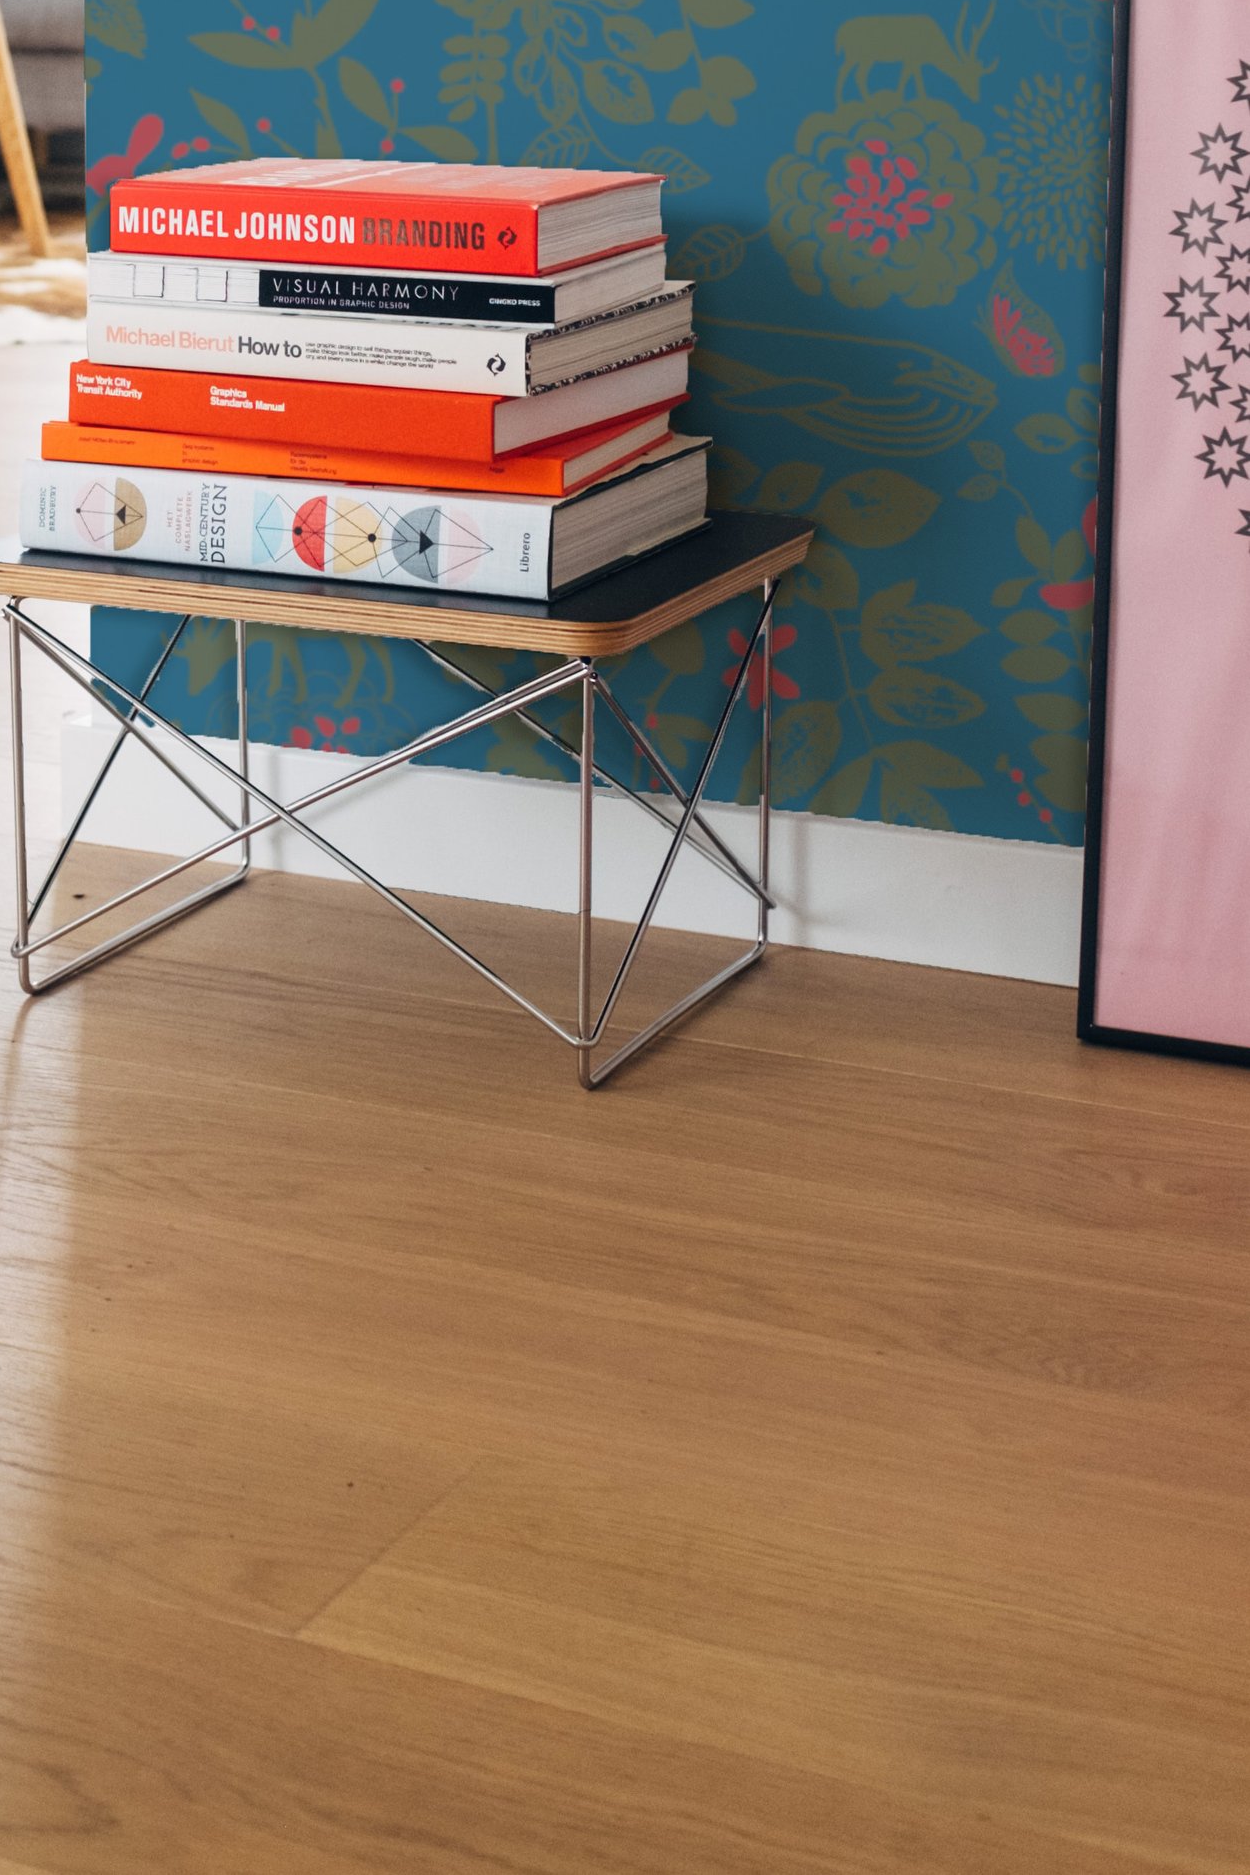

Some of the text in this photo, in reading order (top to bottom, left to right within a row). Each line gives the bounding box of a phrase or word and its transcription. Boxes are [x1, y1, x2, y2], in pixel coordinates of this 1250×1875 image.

[118, 206, 486, 251] MICHAEL JOHNSON BRANDING
[273, 278, 460, 302] VISUAL HARMONY
[273, 295, 326, 306] PROPORTION
[339, 299, 376, 309] GRAPHIC
[379, 301, 410, 310] DESIGN
[488, 297, 541, 307] GINGKO PRESS
[105, 325, 302, 359] Michael Bierut How to
[76, 373, 131, 389] New York City
[76, 383, 142, 400] Transit Authority
[210, 385, 247, 398] Graphics
[210, 396, 285, 412] Standards Manual
[38, 486, 46, 528] DOMINIC
[175, 496, 184, 544] COMPLETE
[198, 482, 210, 562] MID-CENTURY
[211, 484, 228, 564] DESIGN
[519, 532, 531, 573] Librero
